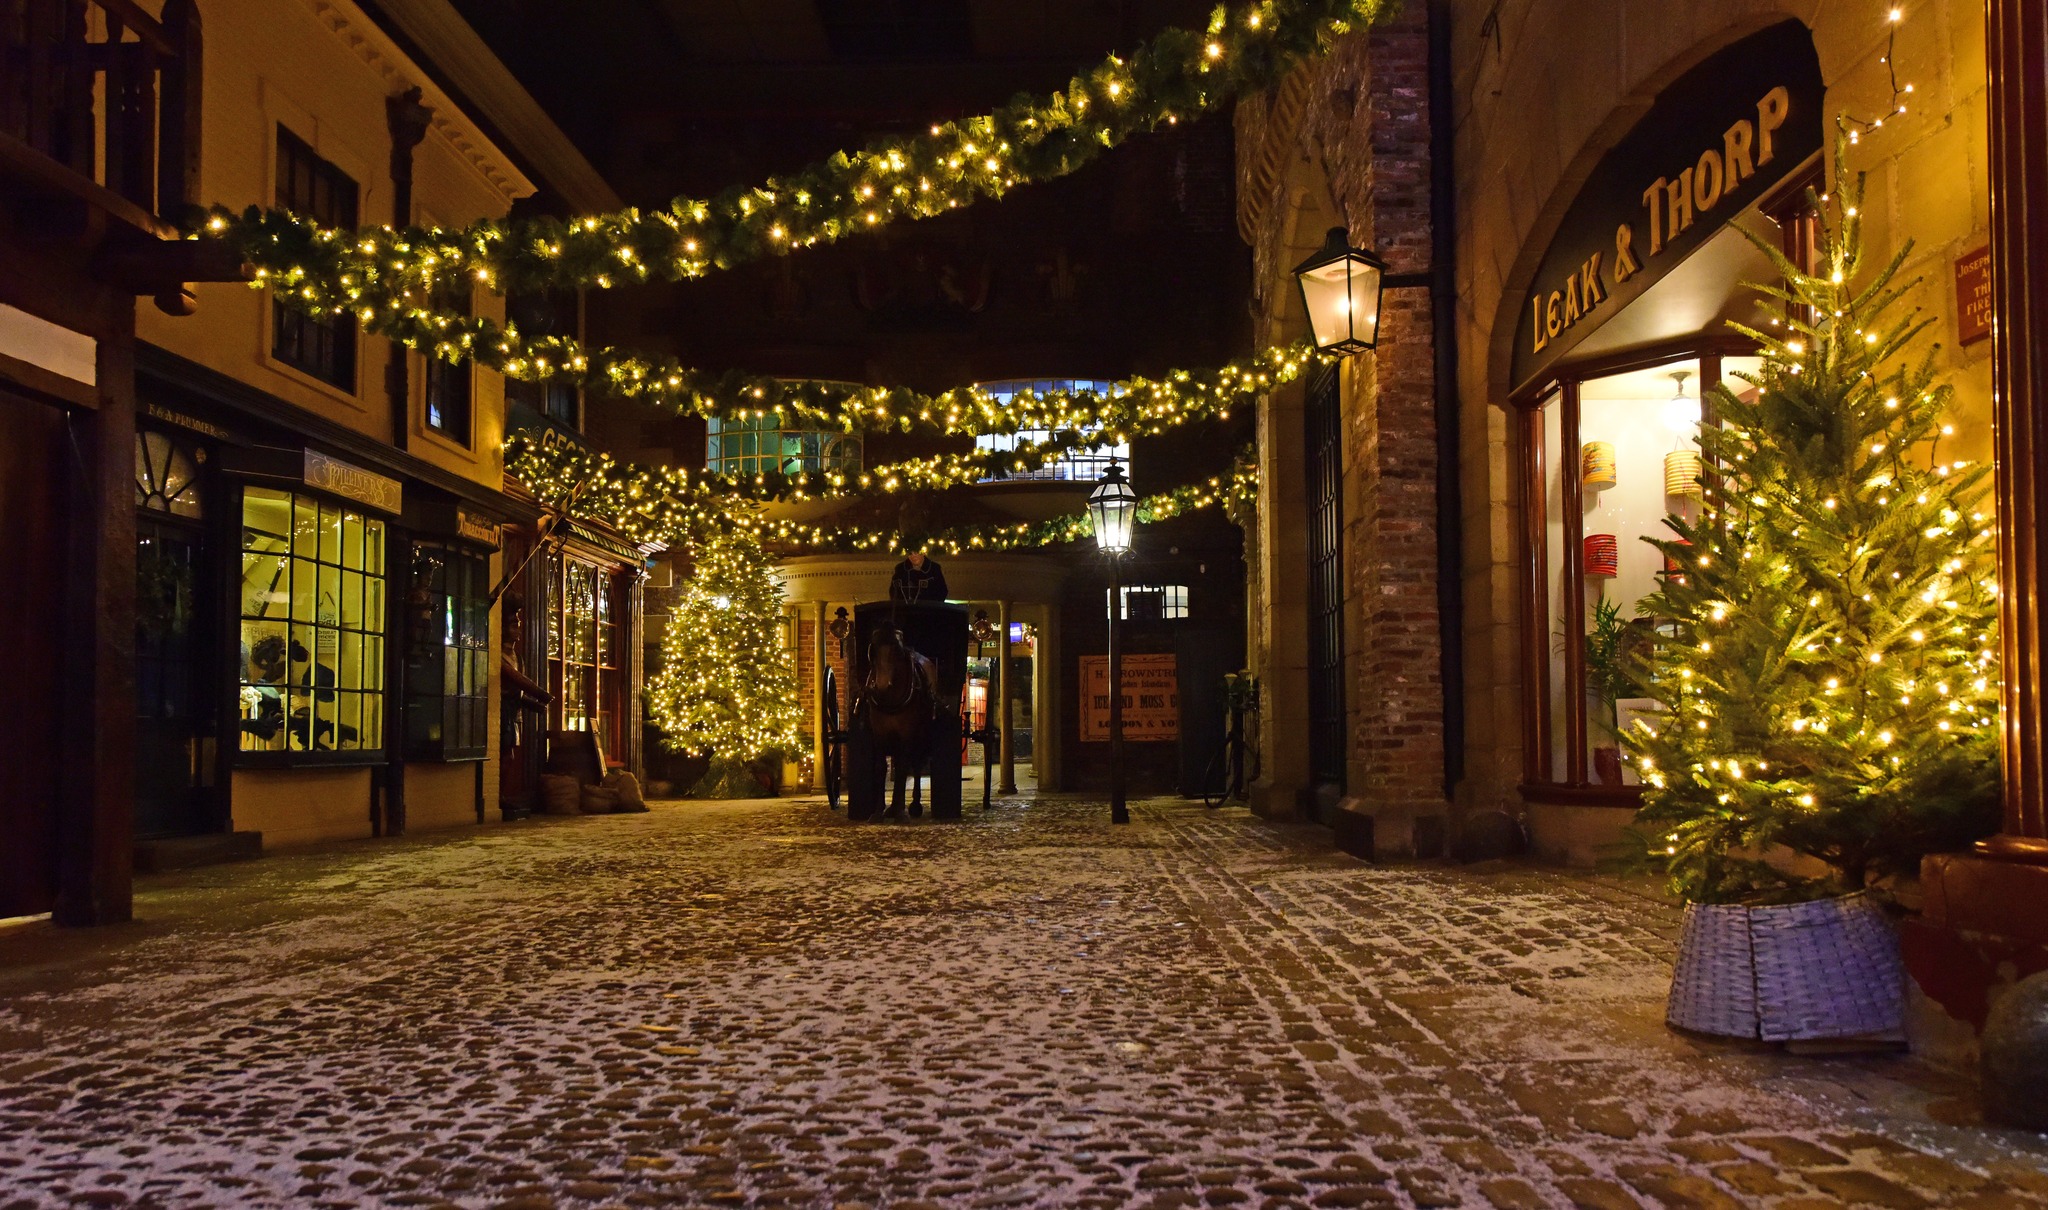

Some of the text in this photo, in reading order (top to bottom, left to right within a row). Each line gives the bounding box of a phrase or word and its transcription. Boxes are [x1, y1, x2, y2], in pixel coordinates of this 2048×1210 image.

[1532, 85, 1790, 354] LEAK & THORP
[1140, 694, 1164, 708] MOSS
[1098, 720, 1142, 728] LODON
